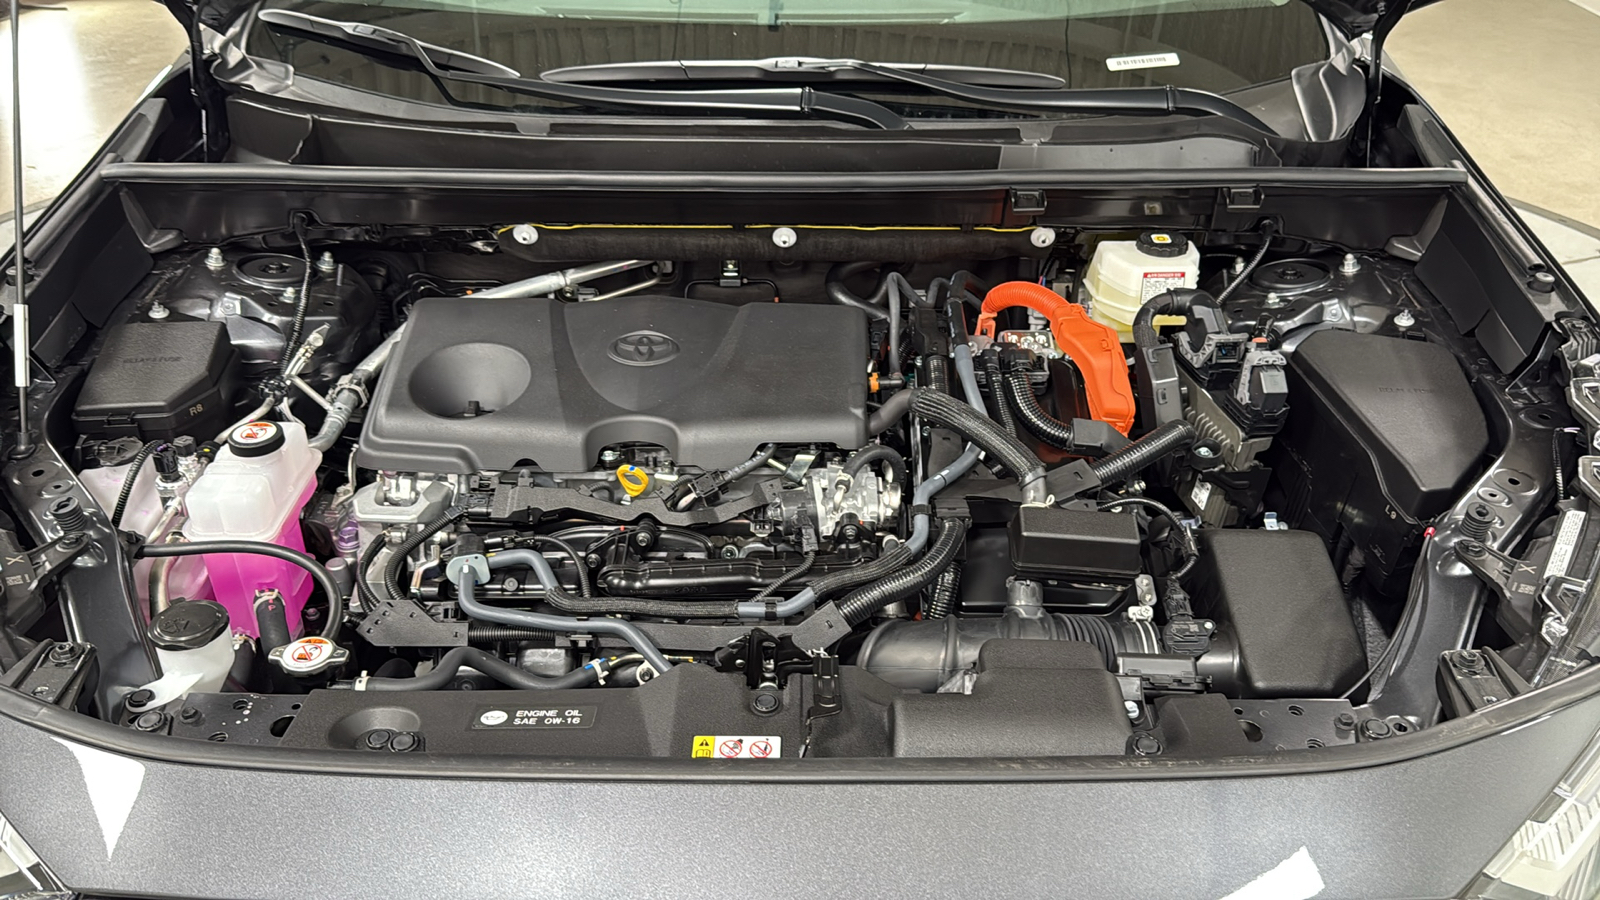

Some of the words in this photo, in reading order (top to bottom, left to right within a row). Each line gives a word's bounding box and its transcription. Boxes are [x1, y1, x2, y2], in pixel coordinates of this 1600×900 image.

[189, 403, 203, 416] R8
[515, 709, 559, 717] ENGINE
[564, 709, 583, 717] OIL
[513, 717, 538, 725] SAE
[544, 717, 581, 725] 0W-16
